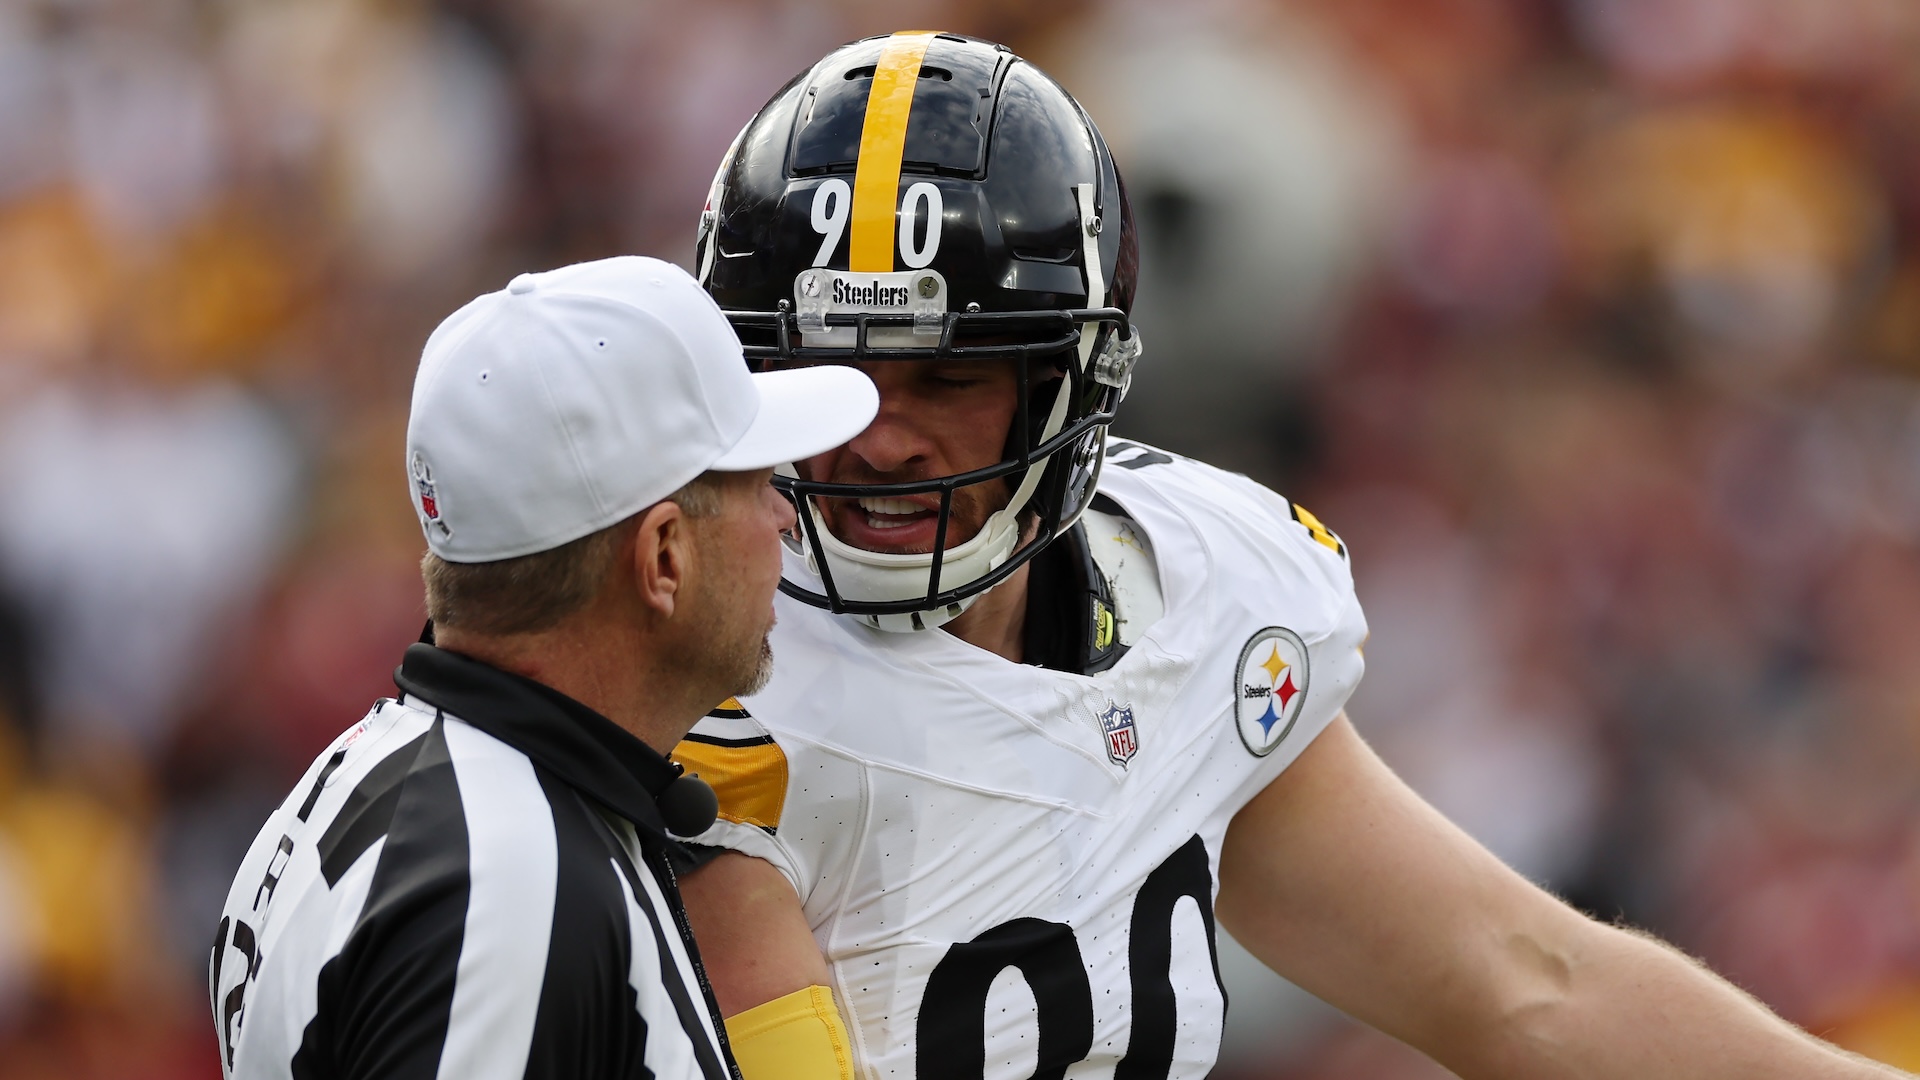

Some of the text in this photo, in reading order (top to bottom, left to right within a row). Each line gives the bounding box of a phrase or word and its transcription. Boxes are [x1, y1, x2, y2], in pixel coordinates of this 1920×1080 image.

[832, 277, 909, 306] Steelers
[1244, 684, 1271, 699] Steelers
[1109, 729, 1135, 757] NFL
